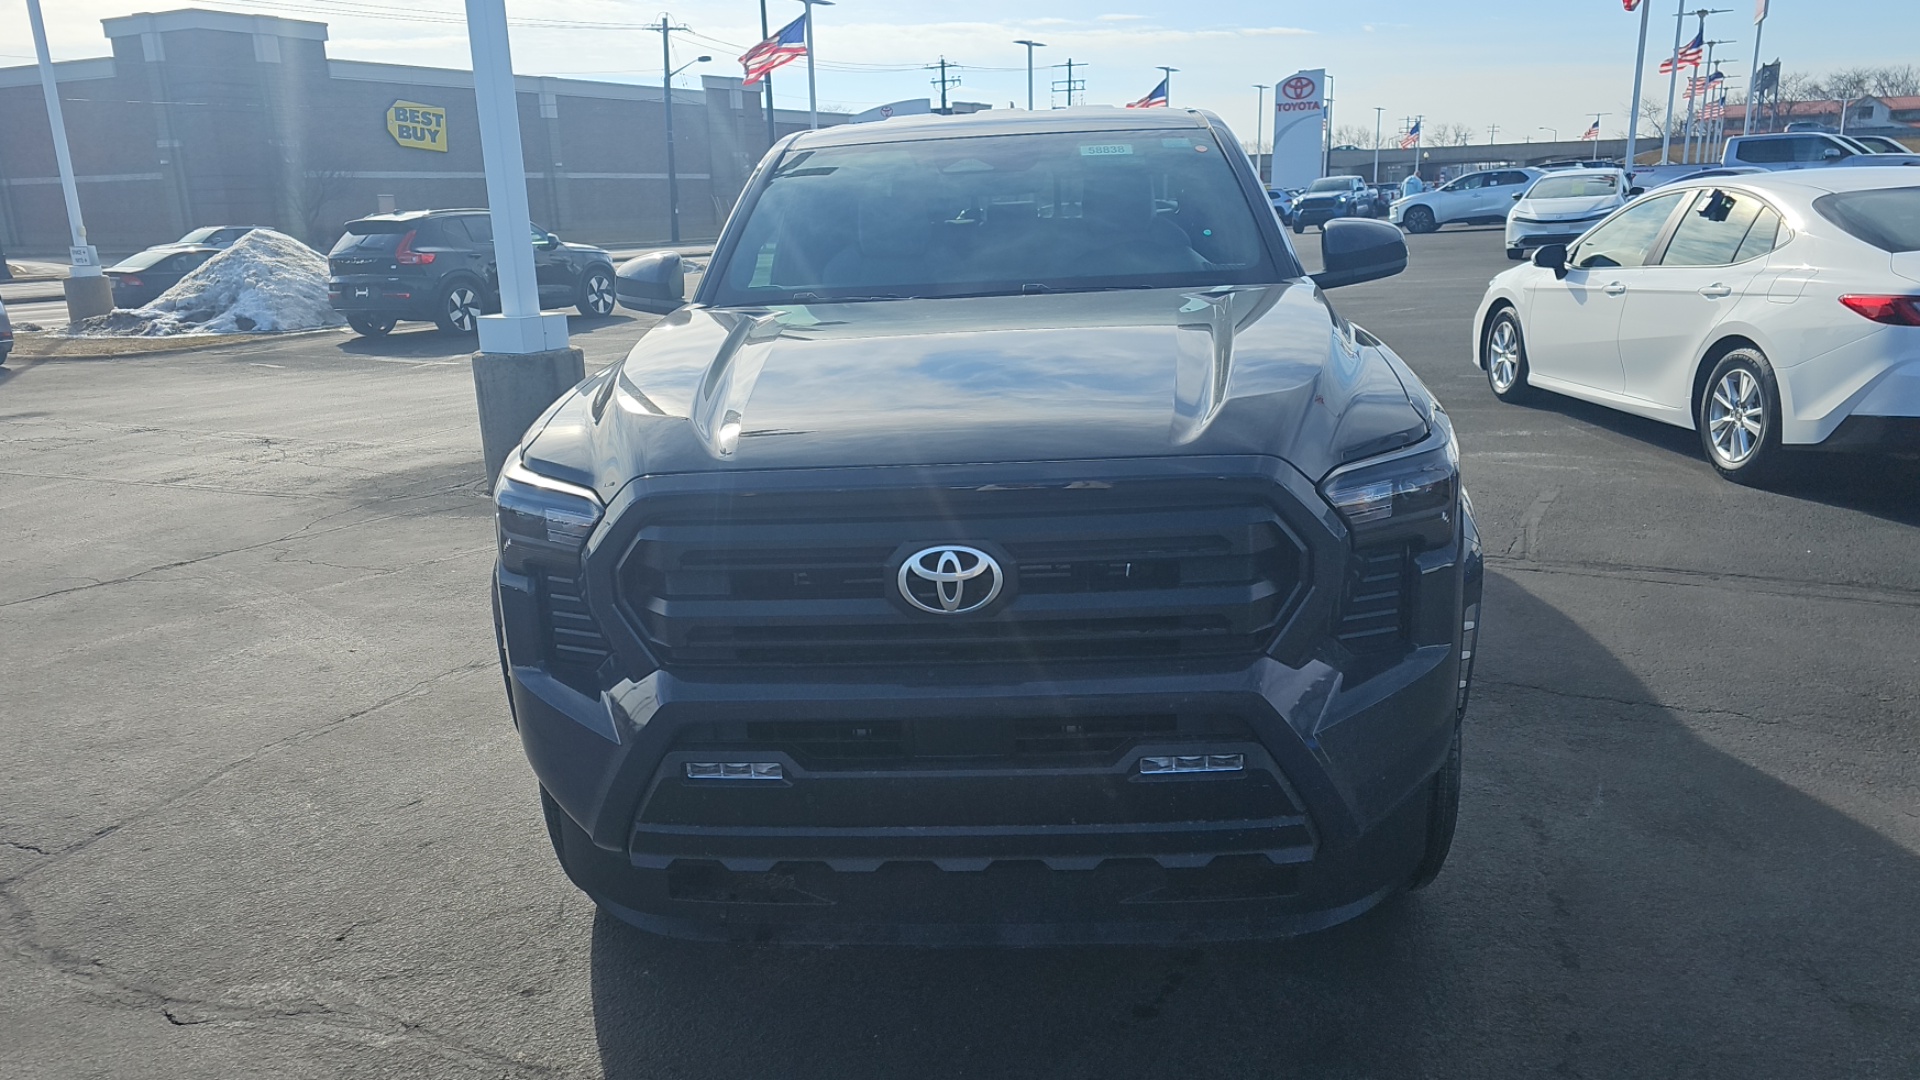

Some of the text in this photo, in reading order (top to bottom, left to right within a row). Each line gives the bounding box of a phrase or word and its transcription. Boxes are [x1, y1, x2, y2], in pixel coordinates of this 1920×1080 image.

[1276, 101, 1321, 112] TOYOTA
[394, 107, 444, 128] BEST
[398, 124, 440, 143] BUY
[1088, 145, 1125, 155] 58838
